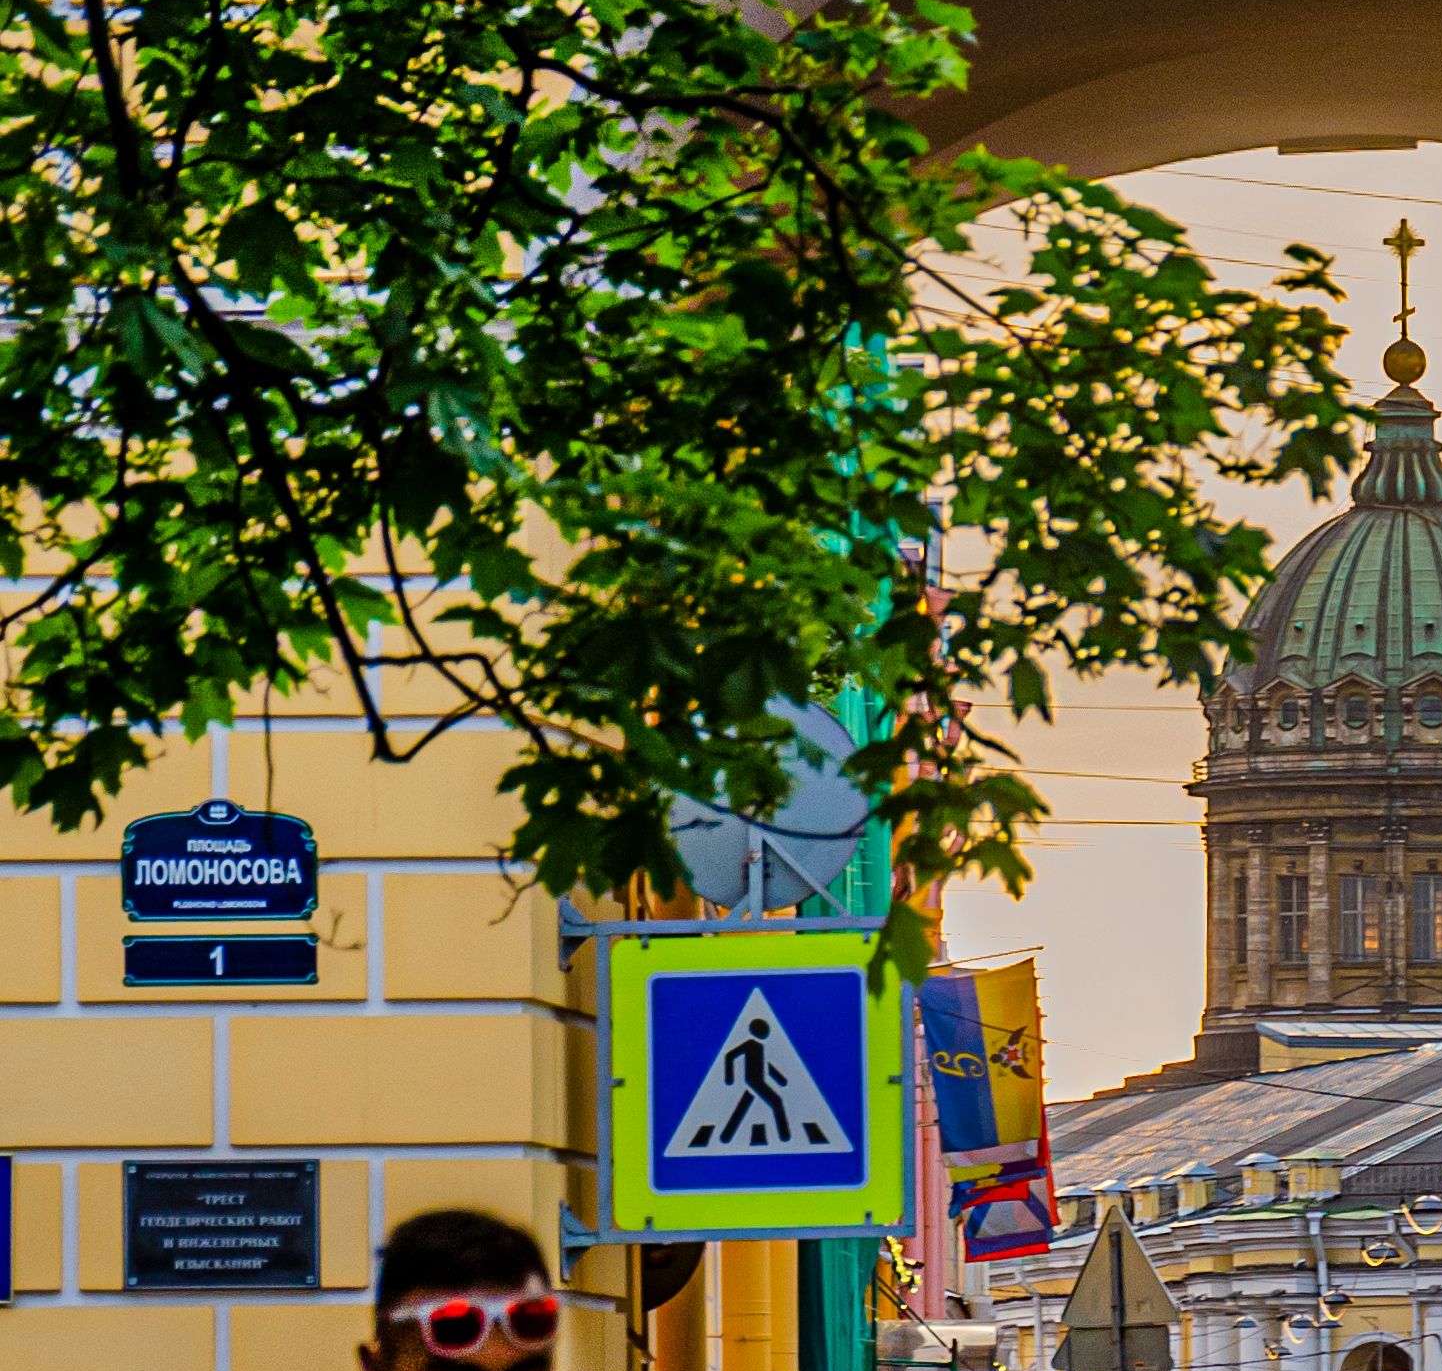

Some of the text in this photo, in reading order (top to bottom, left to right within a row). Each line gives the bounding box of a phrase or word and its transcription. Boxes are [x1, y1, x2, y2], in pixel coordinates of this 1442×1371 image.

[187, 839, 251, 854] ПЛОЩАДЬ
[135, 858, 302, 886] ЛОМОНОСОВА
[209, 945, 224, 976] 1
[259, 1214, 303, 1227] РАБОТ
[164, 1236, 280, 1249] И ИНЖЕНЕРНЫХ
